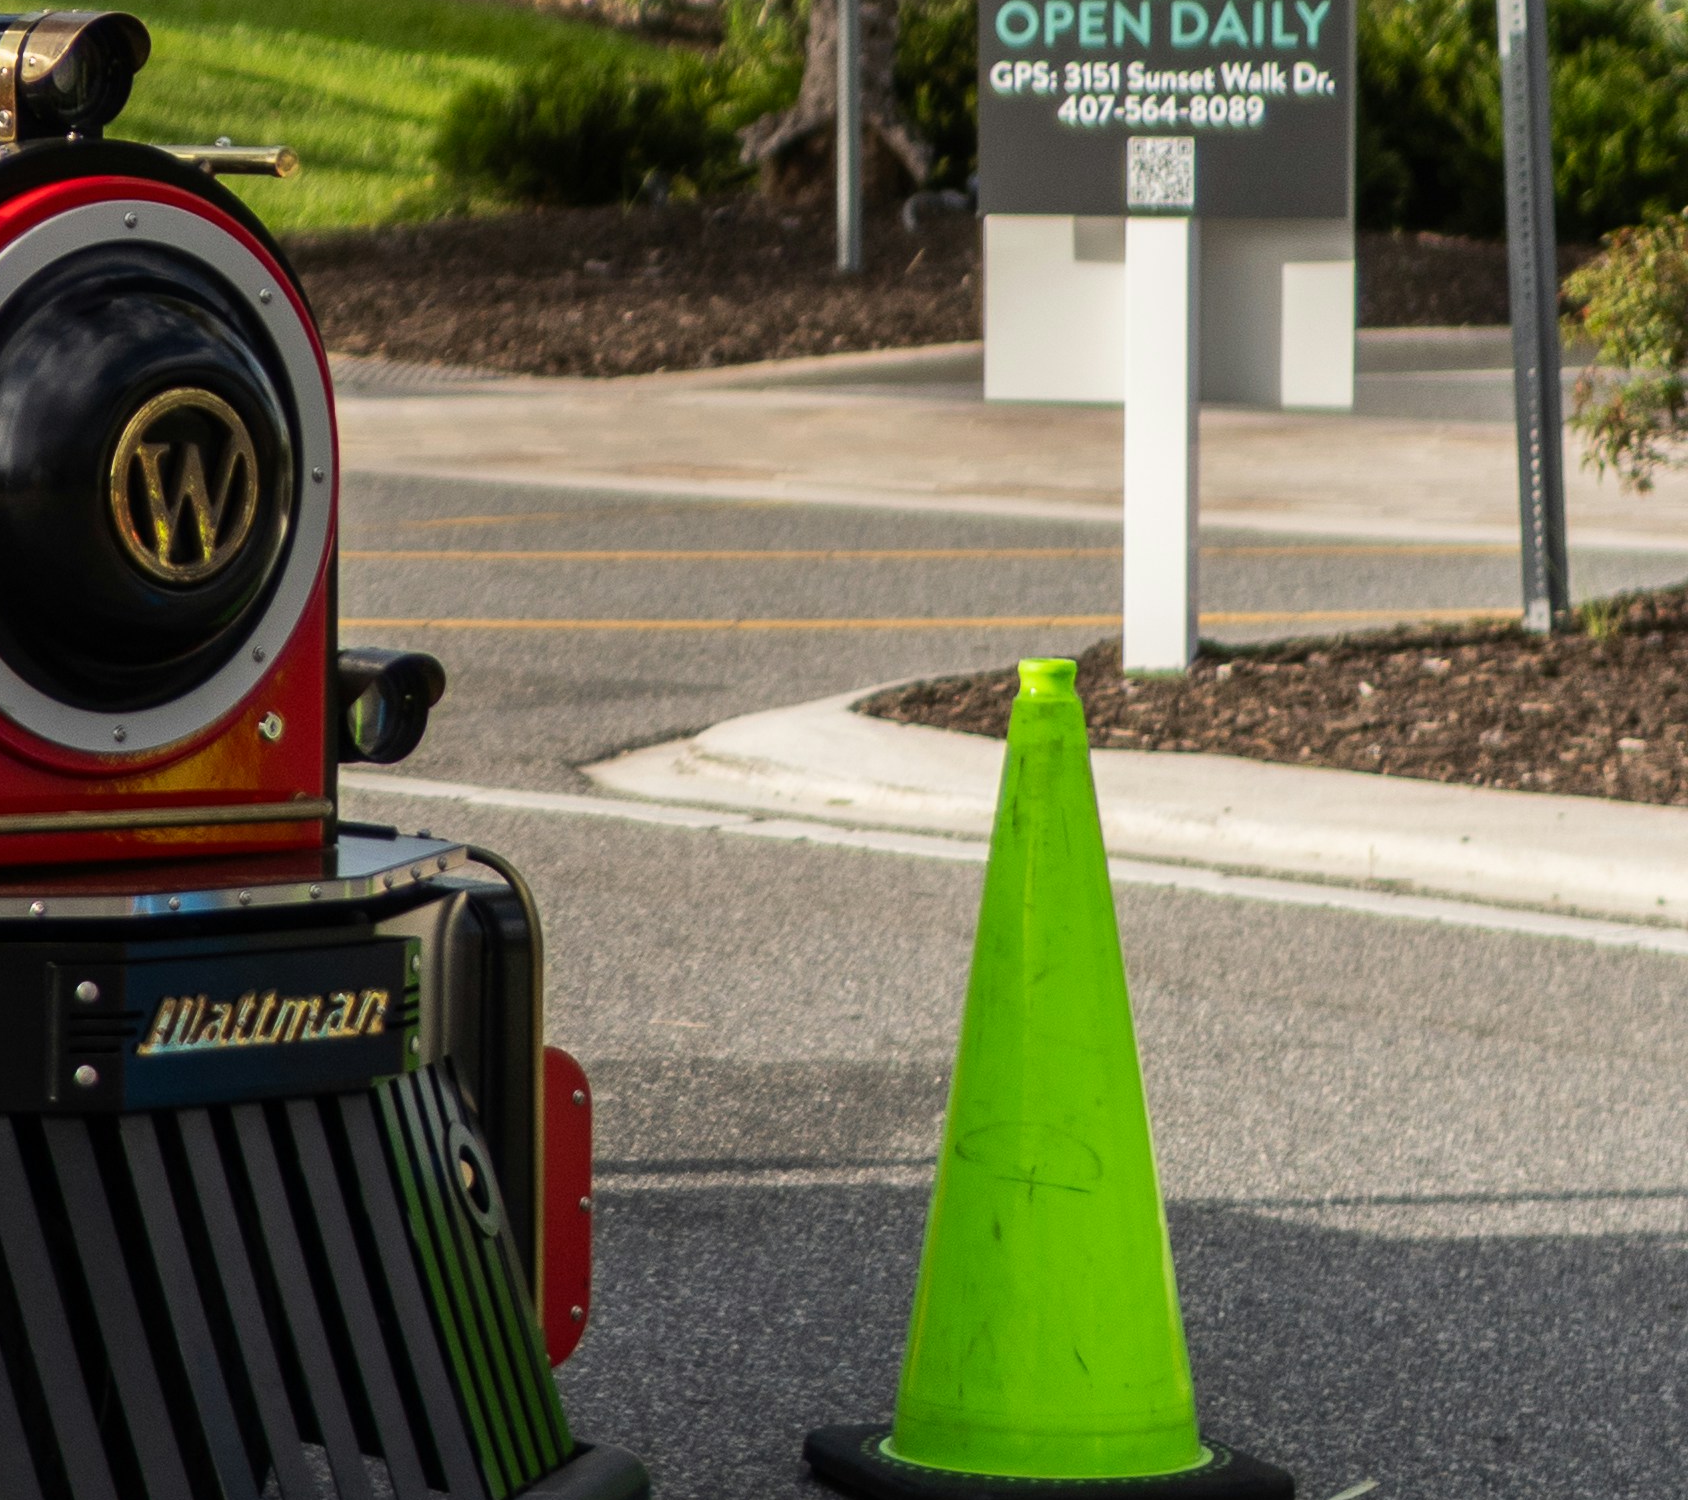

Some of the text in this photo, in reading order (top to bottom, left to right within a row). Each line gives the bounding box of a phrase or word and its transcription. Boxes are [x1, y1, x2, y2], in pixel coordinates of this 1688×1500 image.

[996, 0, 1330, 47] OPEN DAILY
[990, 61, 1335, 94] GPS: 3151 Sunset Walk Dr.
[1058, 96, 1264, 127] 407-564-8089
[135, 989, 389, 1056] Wattman
